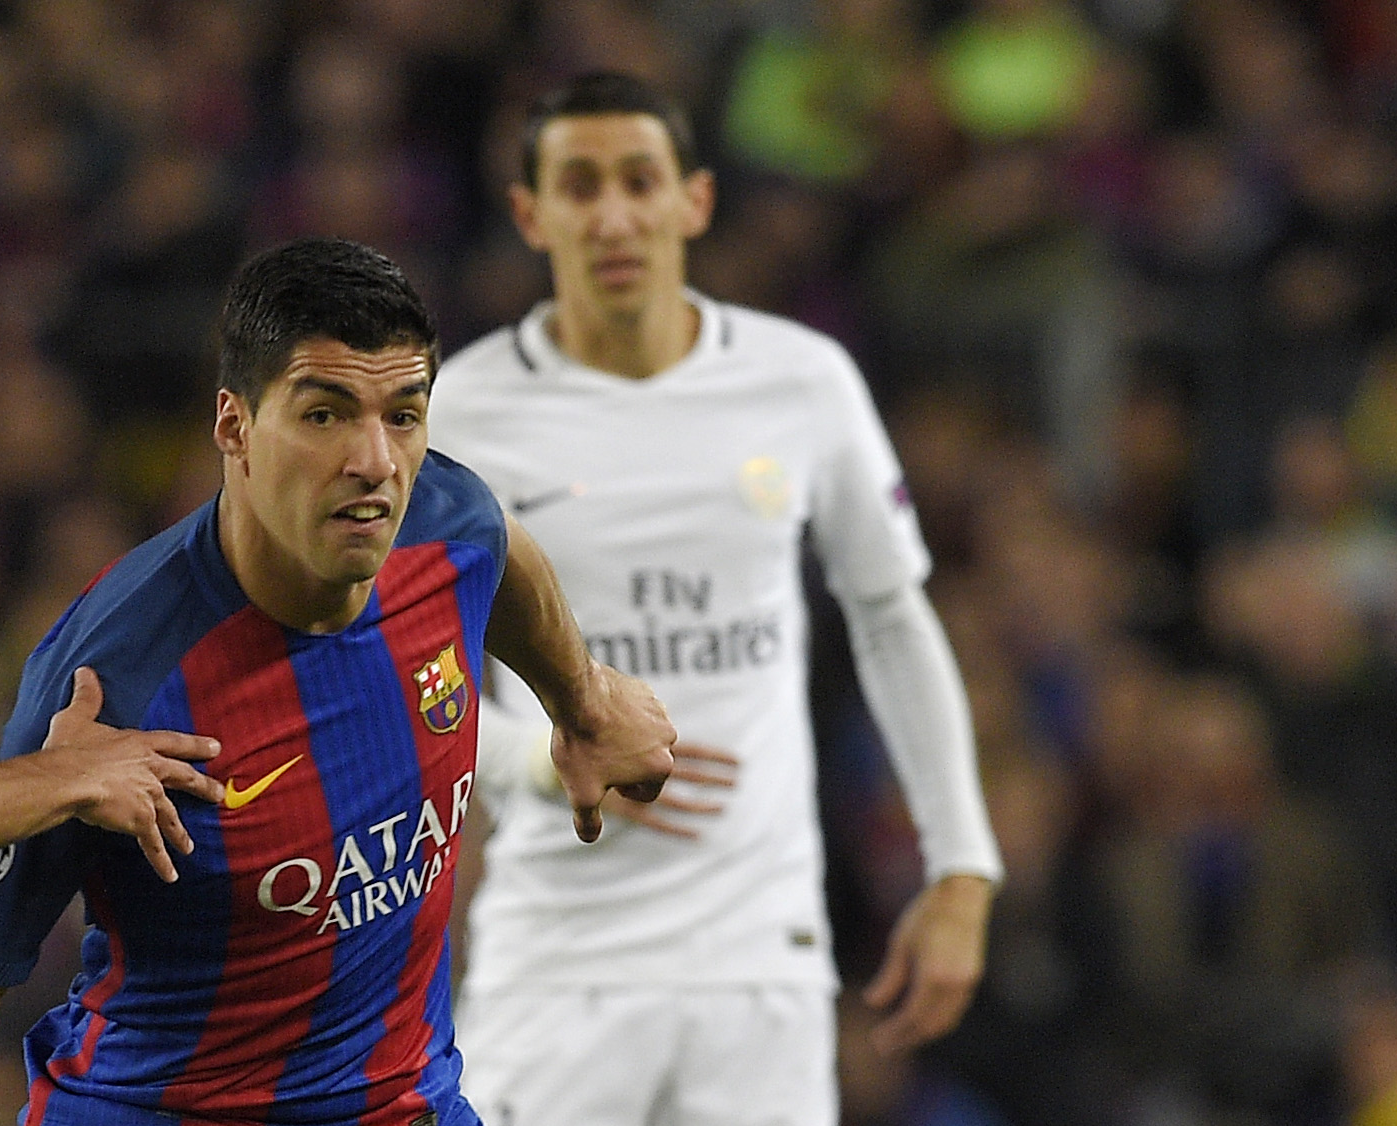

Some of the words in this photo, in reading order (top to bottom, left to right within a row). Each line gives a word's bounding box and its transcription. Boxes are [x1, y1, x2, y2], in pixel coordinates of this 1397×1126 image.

[584, 611, 781, 677] mirates
[257, 770, 474, 916] QATAR
[316, 845, 451, 936] AIRWA
